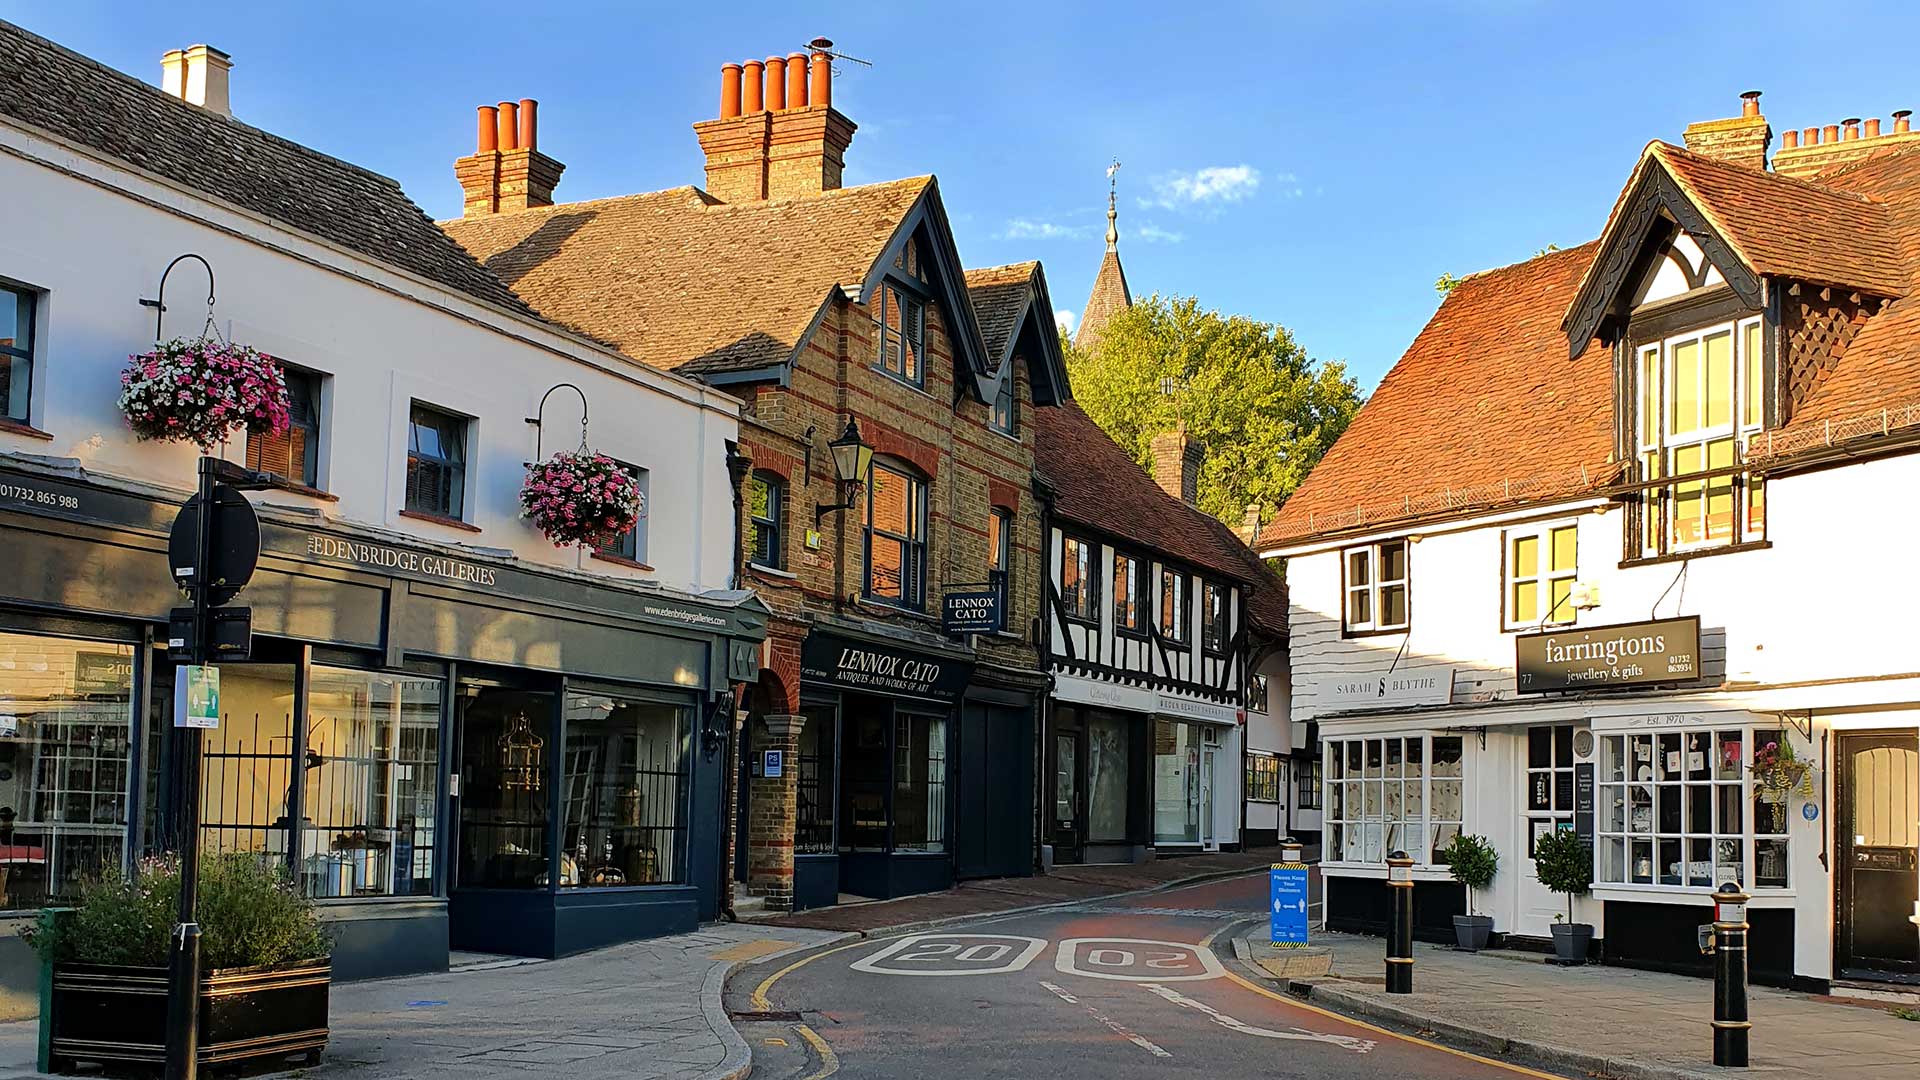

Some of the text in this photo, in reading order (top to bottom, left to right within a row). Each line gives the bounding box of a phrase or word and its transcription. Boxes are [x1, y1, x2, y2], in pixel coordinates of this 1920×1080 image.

[36, 491, 57, 505] 865
[59, 495, 79, 509] 988
[314, 536, 418, 571] EDENBRIDGE
[421, 557, 496, 585] GALLERIES
[949, 597, 994, 608] LENNOX
[644, 606, 726, 625] www.edenbridgegalleries.com
[955, 608, 987, 618] CATO
[1545, 634, 1665, 665] farringtons
[837, 648, 901, 676] LENNOX
[902, 660, 940, 683] CATO
[1669, 654, 1691, 664] 01732
[836, 671, 869, 683] ANTIQUES
[869, 676, 885, 685] AND
[885, 678, 907, 689] WORKS
[907, 682, 917, 690] OF
[916, 684, 930, 693] ART
[1522, 673, 1532, 684] 77
[1566, 664, 1644, 684] jewellery & gifts
[1337, 678, 1436, 694] SARAH BLYTHE
[1666, 714, 1685, 724] 1970
[899, 944, 1009, 961] 20
